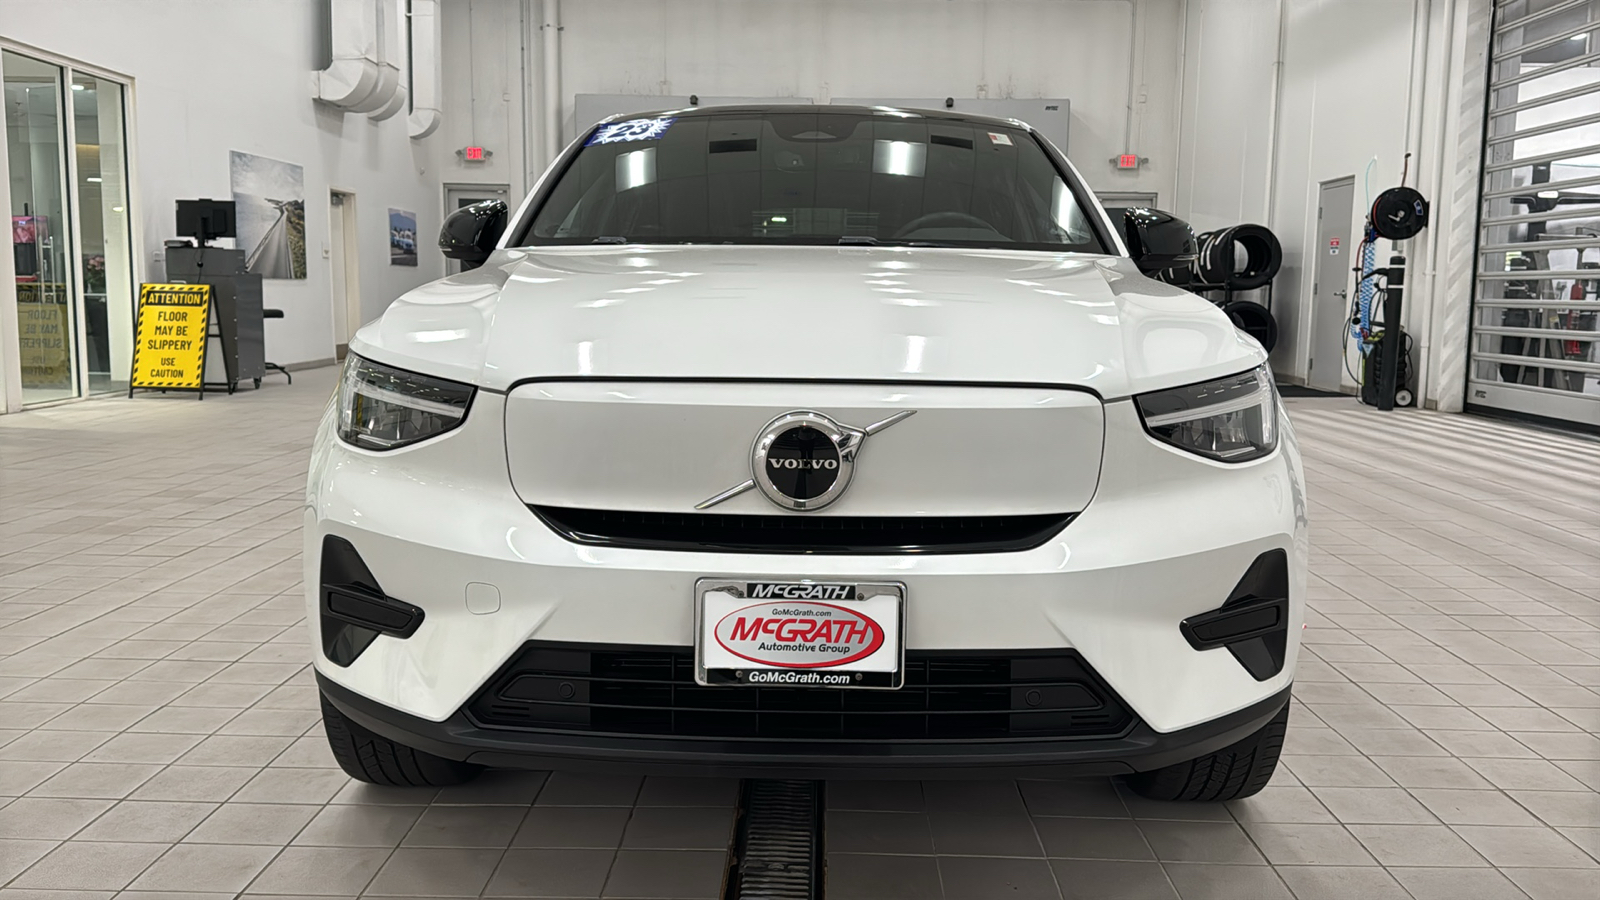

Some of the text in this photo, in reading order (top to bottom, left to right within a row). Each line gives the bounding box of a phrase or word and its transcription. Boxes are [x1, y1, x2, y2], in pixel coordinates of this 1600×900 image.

[607, 123, 654, 138] 23
[467, 147, 482, 159] EXIT
[1120, 154, 1135, 167] EXIT
[147, 292, 201, 304] ATTENTION
[158, 311, 188, 322] FLOOR
[154, 325, 188, 336] MAY BE
[147, 339, 192, 351] SLIPPERY
[160, 357, 176, 367] USE
[150, 368, 184, 378] CAUTION
[768, 458, 838, 470] VOLVO
[771, 608, 832, 618] GoMcGrath.com
[758, 641, 851, 655] Automotive Group
[748, 670, 851, 685] GoMcGrath.com
